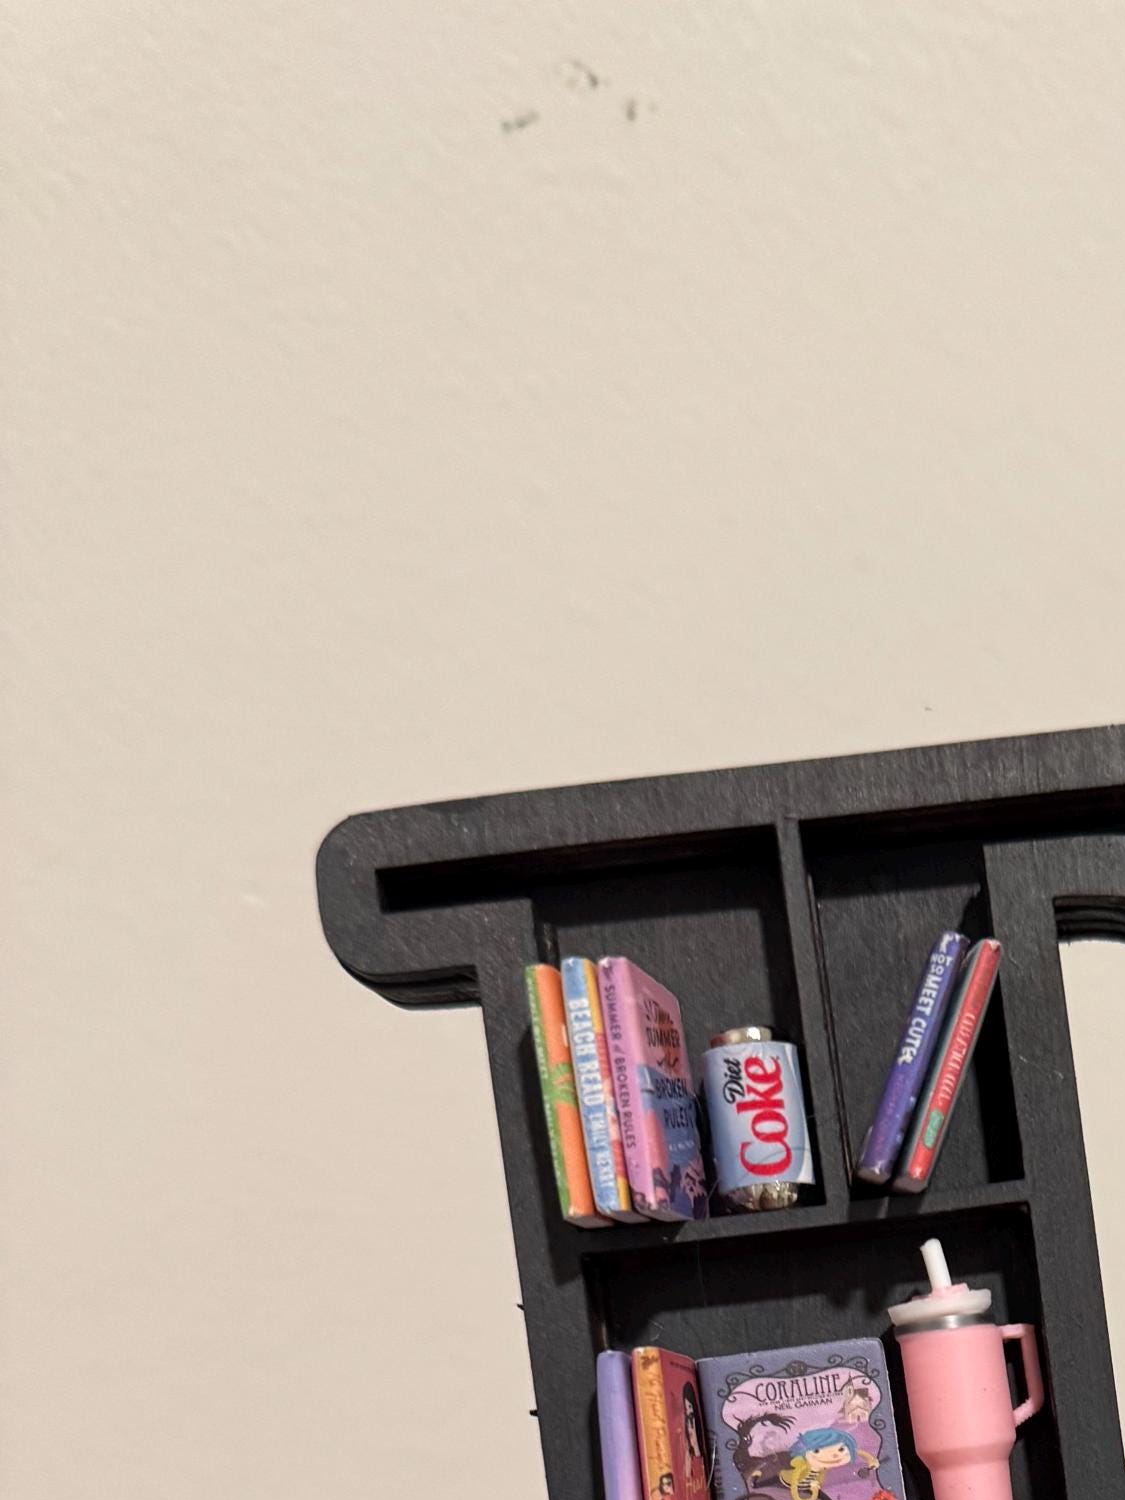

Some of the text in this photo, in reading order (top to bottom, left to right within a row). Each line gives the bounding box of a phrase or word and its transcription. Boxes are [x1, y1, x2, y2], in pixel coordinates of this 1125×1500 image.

[930, 954, 953, 966] NOT
[604, 983, 622, 1043] SUMMER
[917, 974, 947, 1023] MEET
[568, 998, 594, 1052] BEACH
[575, 1055, 598, 1107] READ
[613, 1054, 632, 1113] BROKEN
[722, 1056, 743, 1105] Diet
[621, 1111, 637, 1150] RULES
[735, 1055, 794, 1177] Coke
[754, 1373, 844, 1403] CORALINE
[774, 1401, 794, 1412] NEIL
[794, 1397, 834, 1409] GAIMAN
